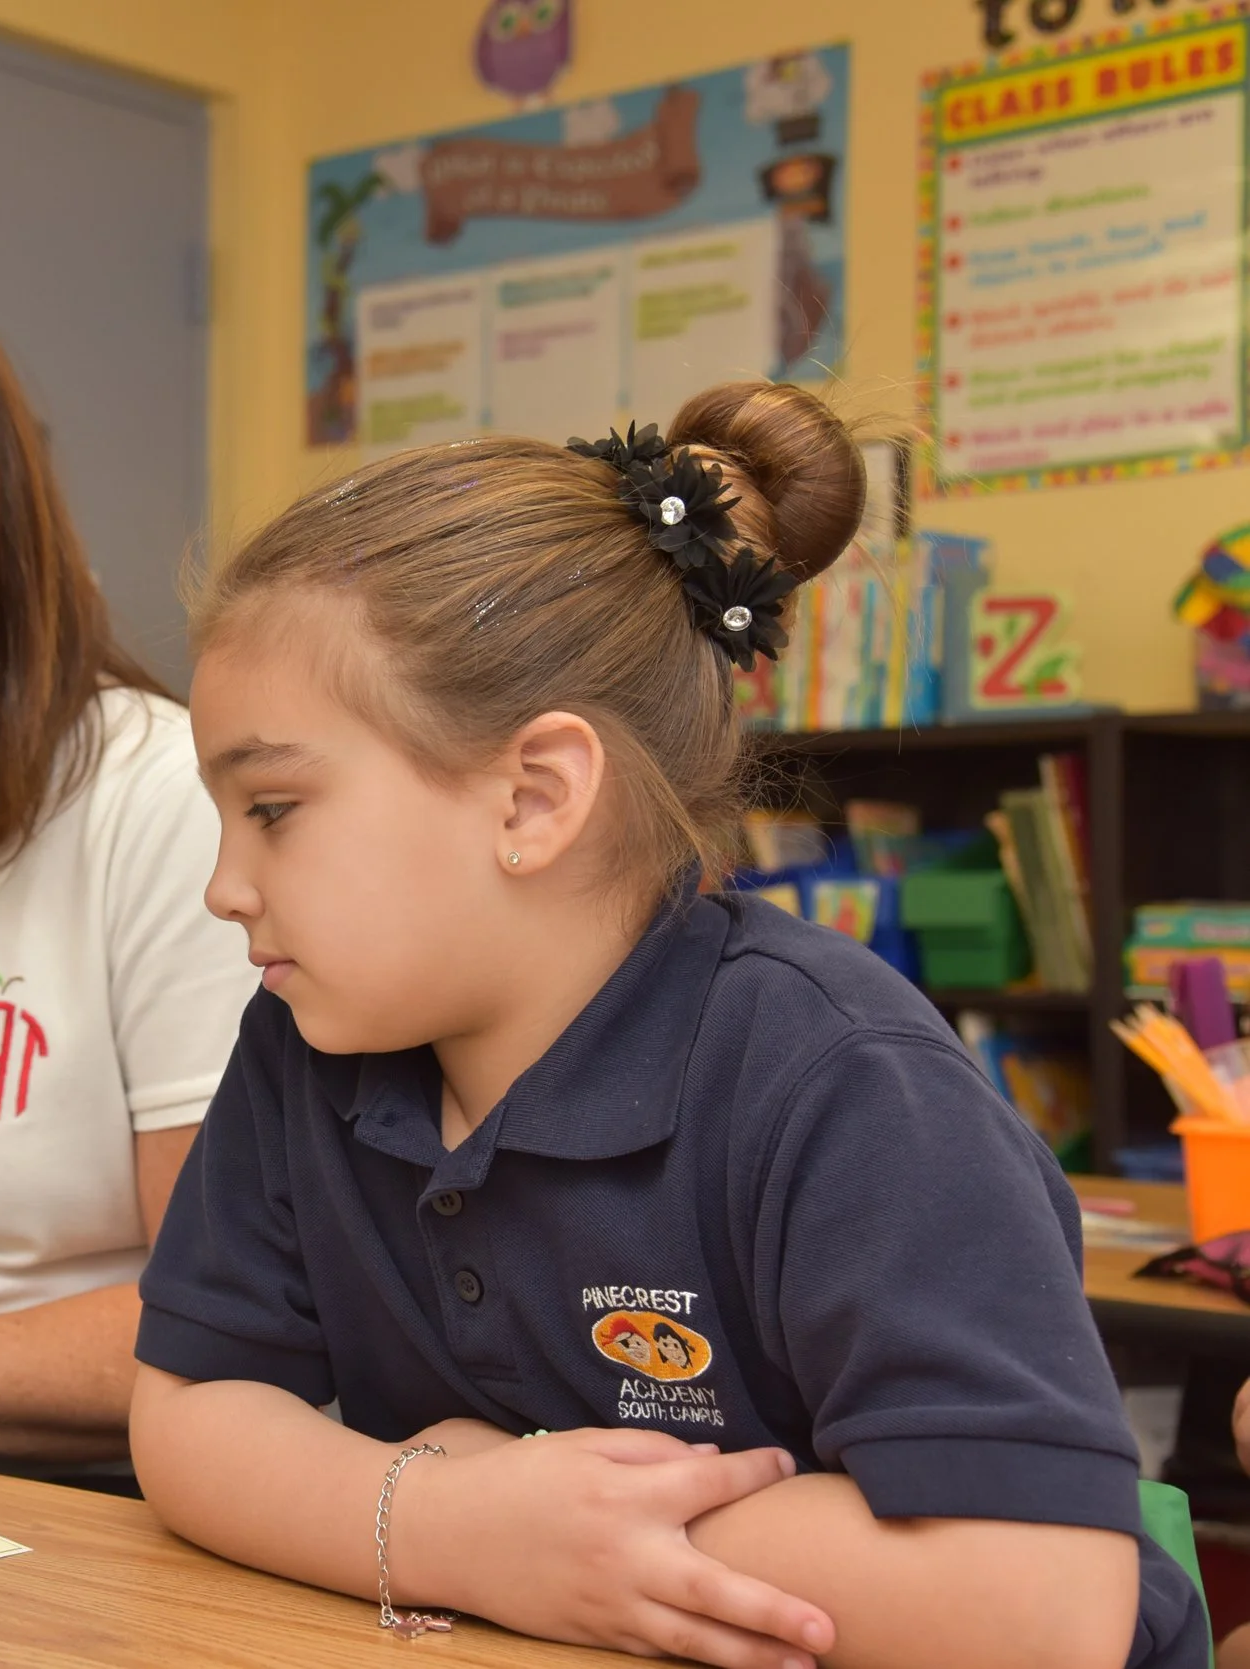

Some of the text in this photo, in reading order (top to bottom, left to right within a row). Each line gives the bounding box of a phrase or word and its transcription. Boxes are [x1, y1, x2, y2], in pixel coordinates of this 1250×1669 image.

[946, 39, 1236, 131] CLASS RULES
[983, 597, 1069, 699] Z
[582, 1284, 699, 1316] PINECREST
[619, 1377, 717, 1407] ACADEMY
[670, 1405, 725, 1428] CAMPUS
